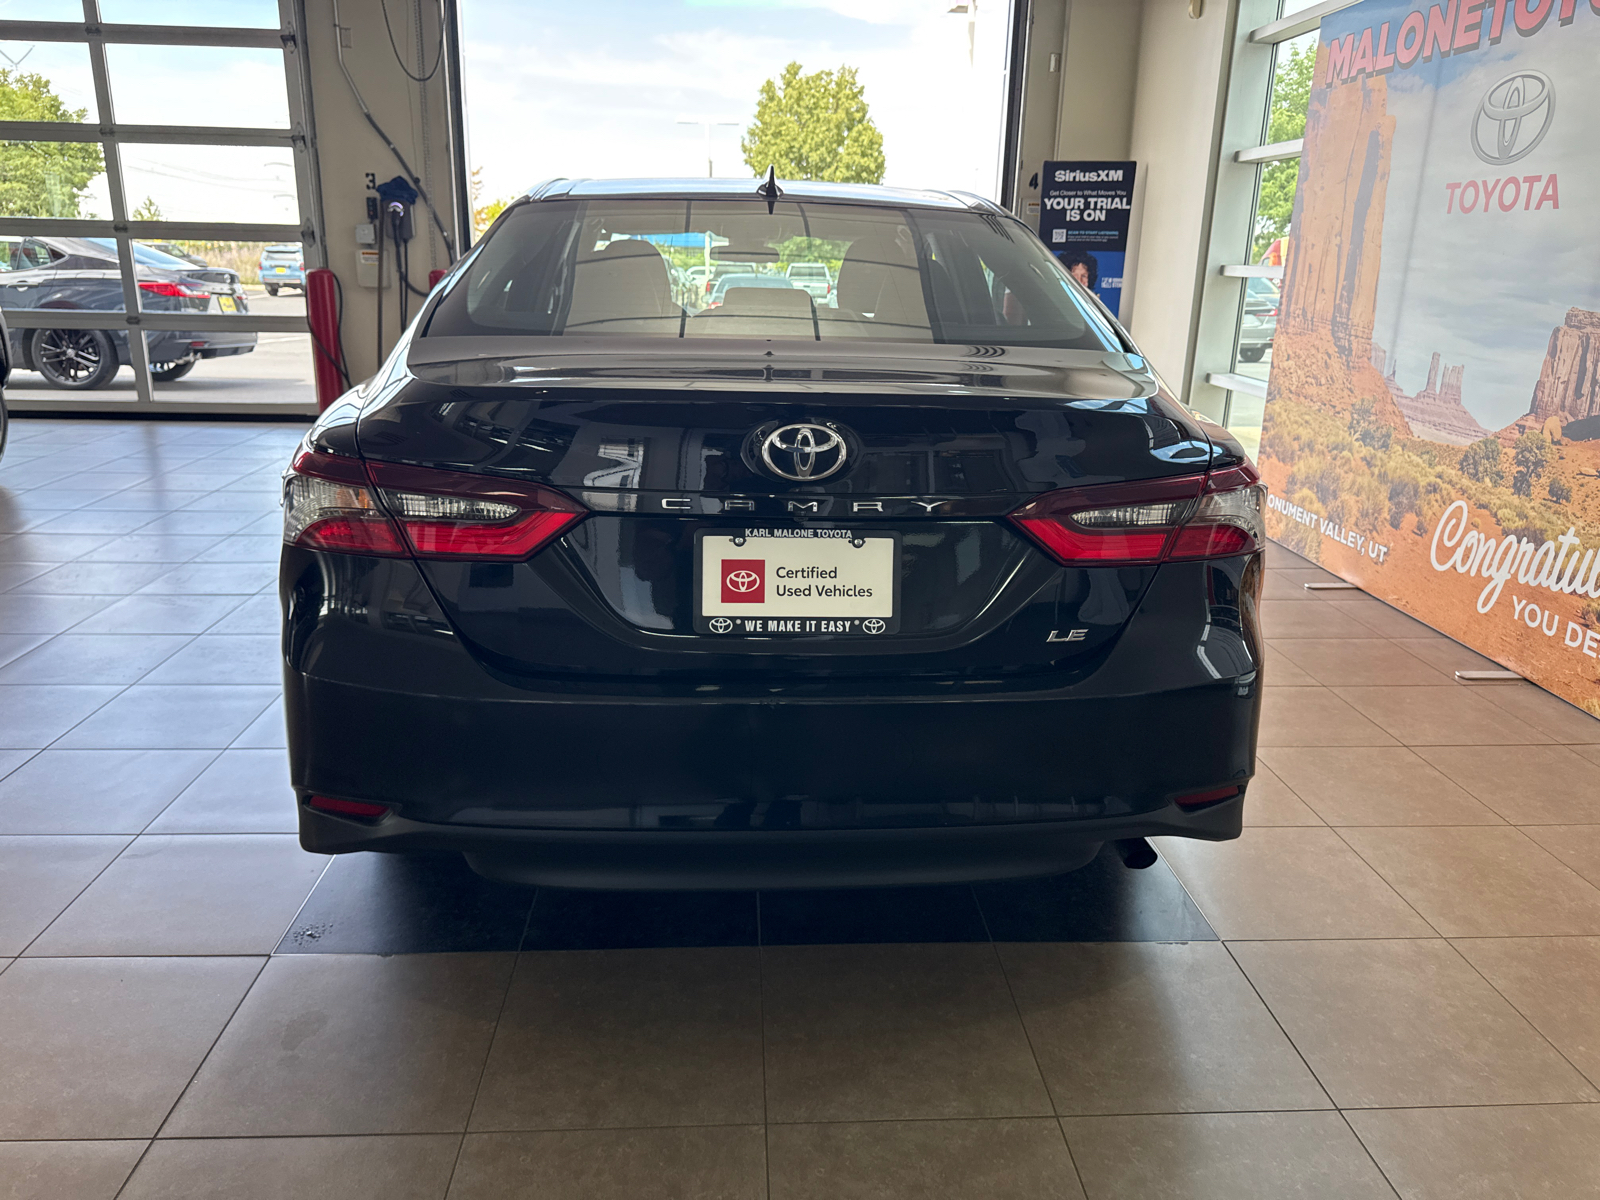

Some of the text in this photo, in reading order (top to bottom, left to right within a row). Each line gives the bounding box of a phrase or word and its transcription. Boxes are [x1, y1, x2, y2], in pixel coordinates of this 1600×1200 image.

[365, 172, 376, 190] 3
[1028, 172, 1039, 190] 4
[1054, 169, 1124, 182] SiriusXM
[1445, 173, 1560, 215] TOYOTA
[1043, 197, 1131, 210] YOUR TRIAL
[1066, 209, 1106, 222] IS ON
[661, 498, 948, 513] CAMRY
[745, 528, 853, 539] KARL MALONE TOYOTA
[1266, 494, 1388, 563] ONUMENT VALLEY, UT
[775, 566, 838, 579] Certified
[776, 584, 873, 598] Used Vehicles
[1512, 595, 1560, 637] YOU
[745, 620, 851, 632] WE MAKE IT EASY
[1046, 628, 1089, 643] LE
